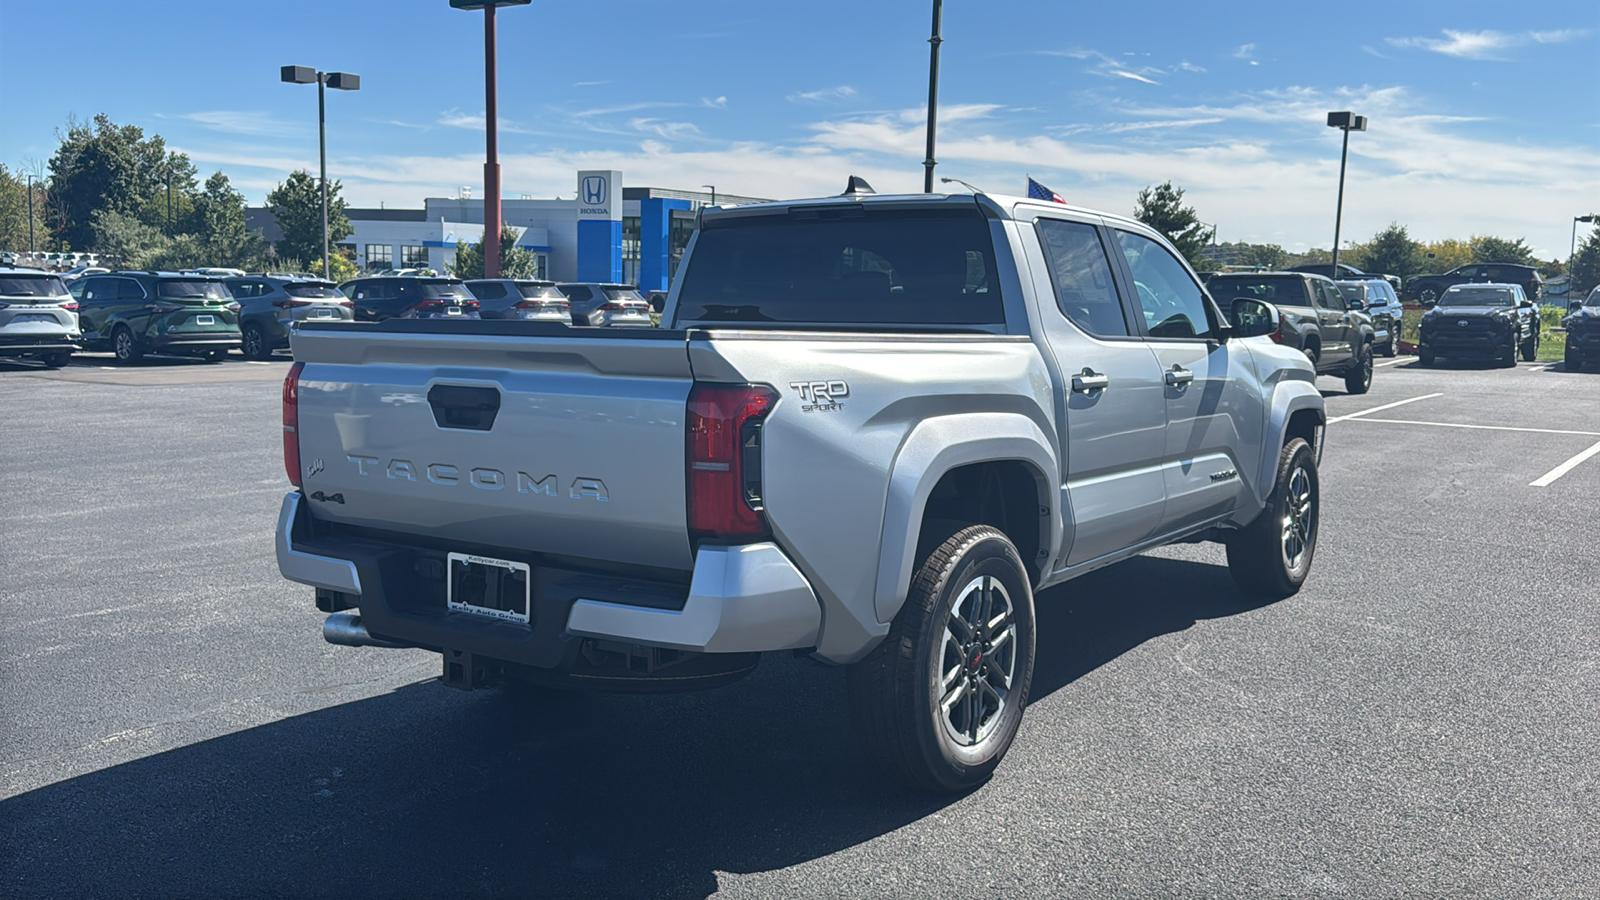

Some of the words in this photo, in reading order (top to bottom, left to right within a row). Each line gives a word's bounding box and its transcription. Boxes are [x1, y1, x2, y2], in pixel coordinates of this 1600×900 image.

[790, 380, 850, 404] TRD
[802, 403, 845, 412] SPORT
[347, 454, 610, 501] TACOMA
[468, 556, 510, 566] Kellycar.com
[452, 604, 474, 613] Kelly
[476, 607, 497, 617] Auto
[499, 613, 525, 622] Group
